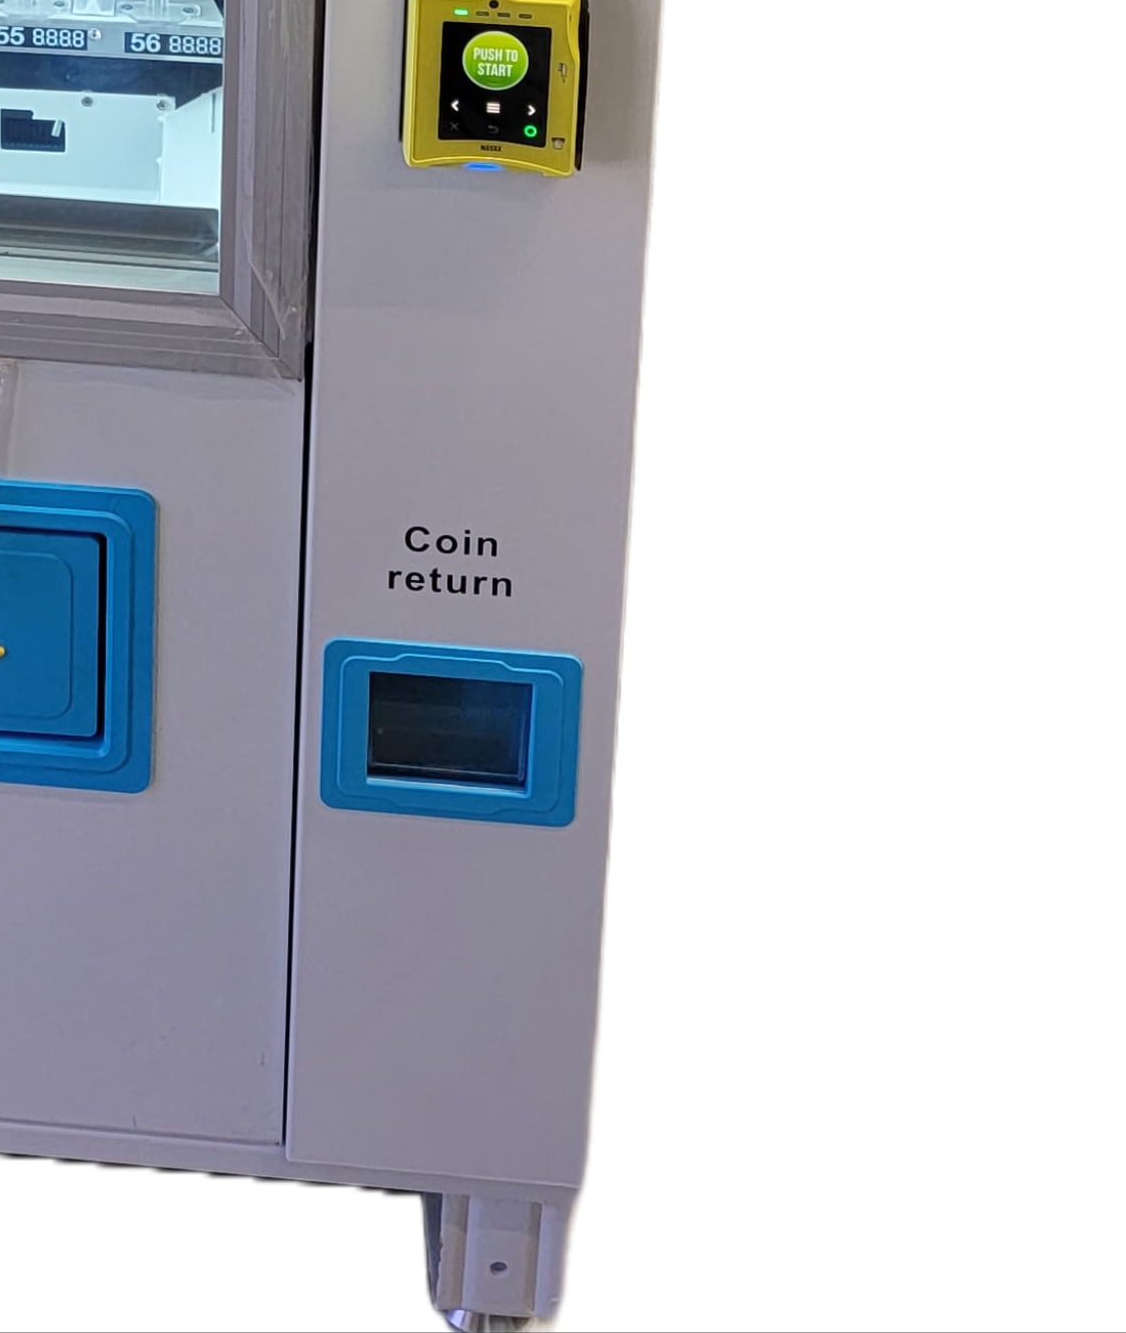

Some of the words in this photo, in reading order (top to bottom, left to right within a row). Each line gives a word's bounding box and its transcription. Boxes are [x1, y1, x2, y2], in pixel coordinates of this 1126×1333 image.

[130, 34, 160, 53] 56
[473, 46, 503, 62] PUSH
[505, 49, 519, 63] TO
[477, 63, 514, 78] START
[404, 526, 499, 557] Coin
[387, 567, 513, 598] return
